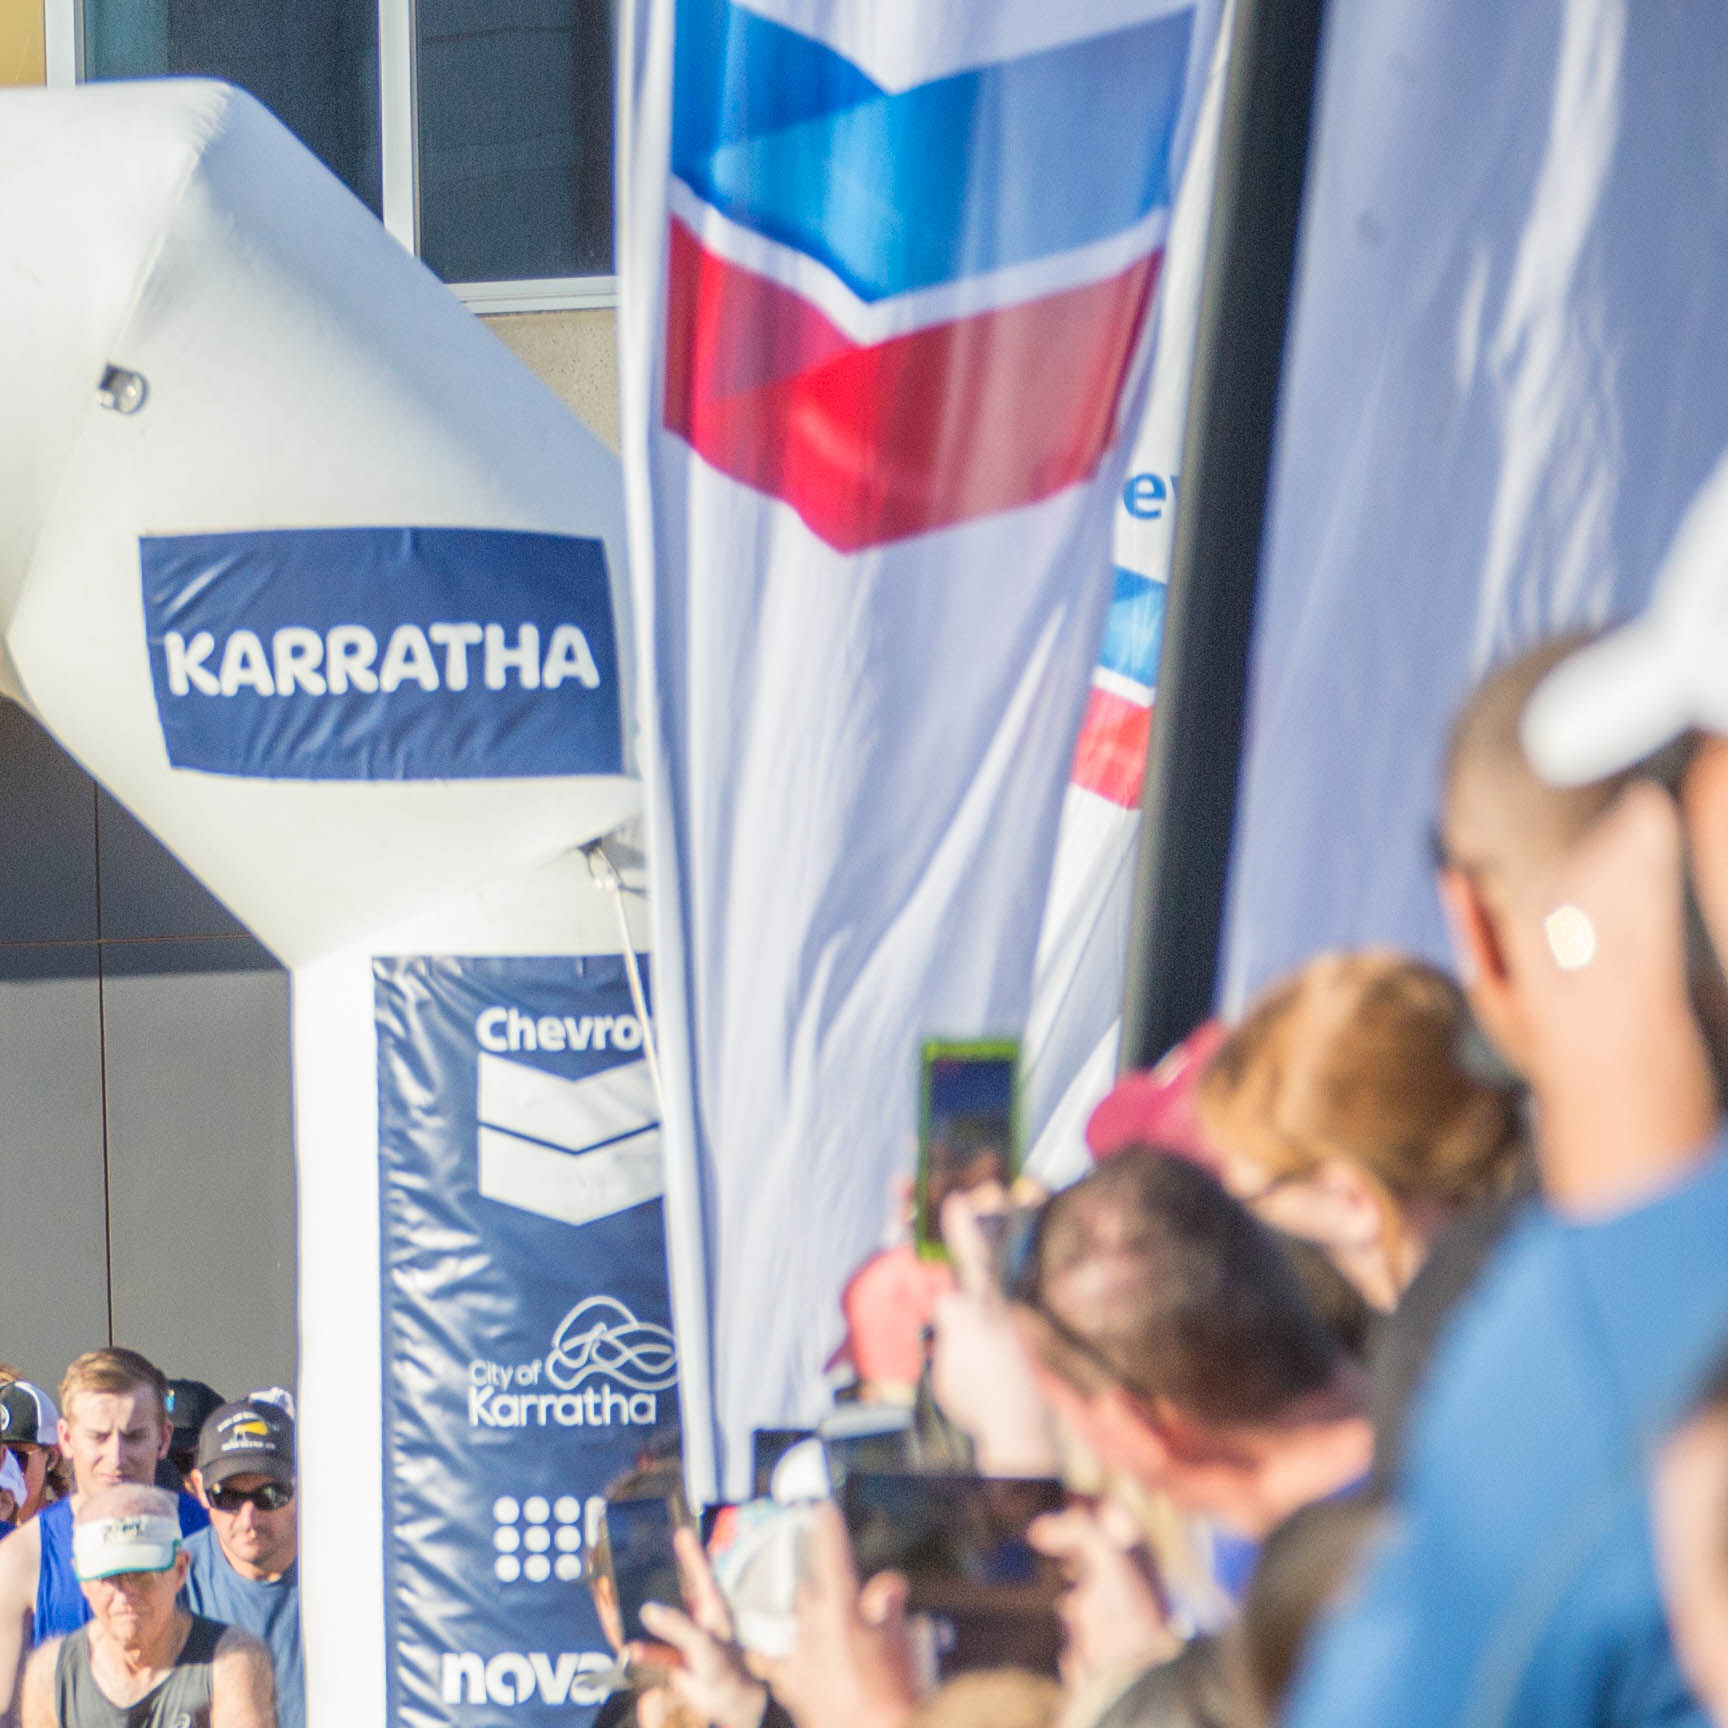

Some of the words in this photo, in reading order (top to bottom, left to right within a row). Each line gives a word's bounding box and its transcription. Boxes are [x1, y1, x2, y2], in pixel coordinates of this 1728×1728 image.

[164, 621, 601, 696] KARRATHA
[476, 1007, 644, 1051] Chevro
[470, 1360, 511, 1390] City
[515, 1360, 542, 1386] of
[468, 1385, 657, 1427] Karratha
[443, 1652, 616, 1706] nova
